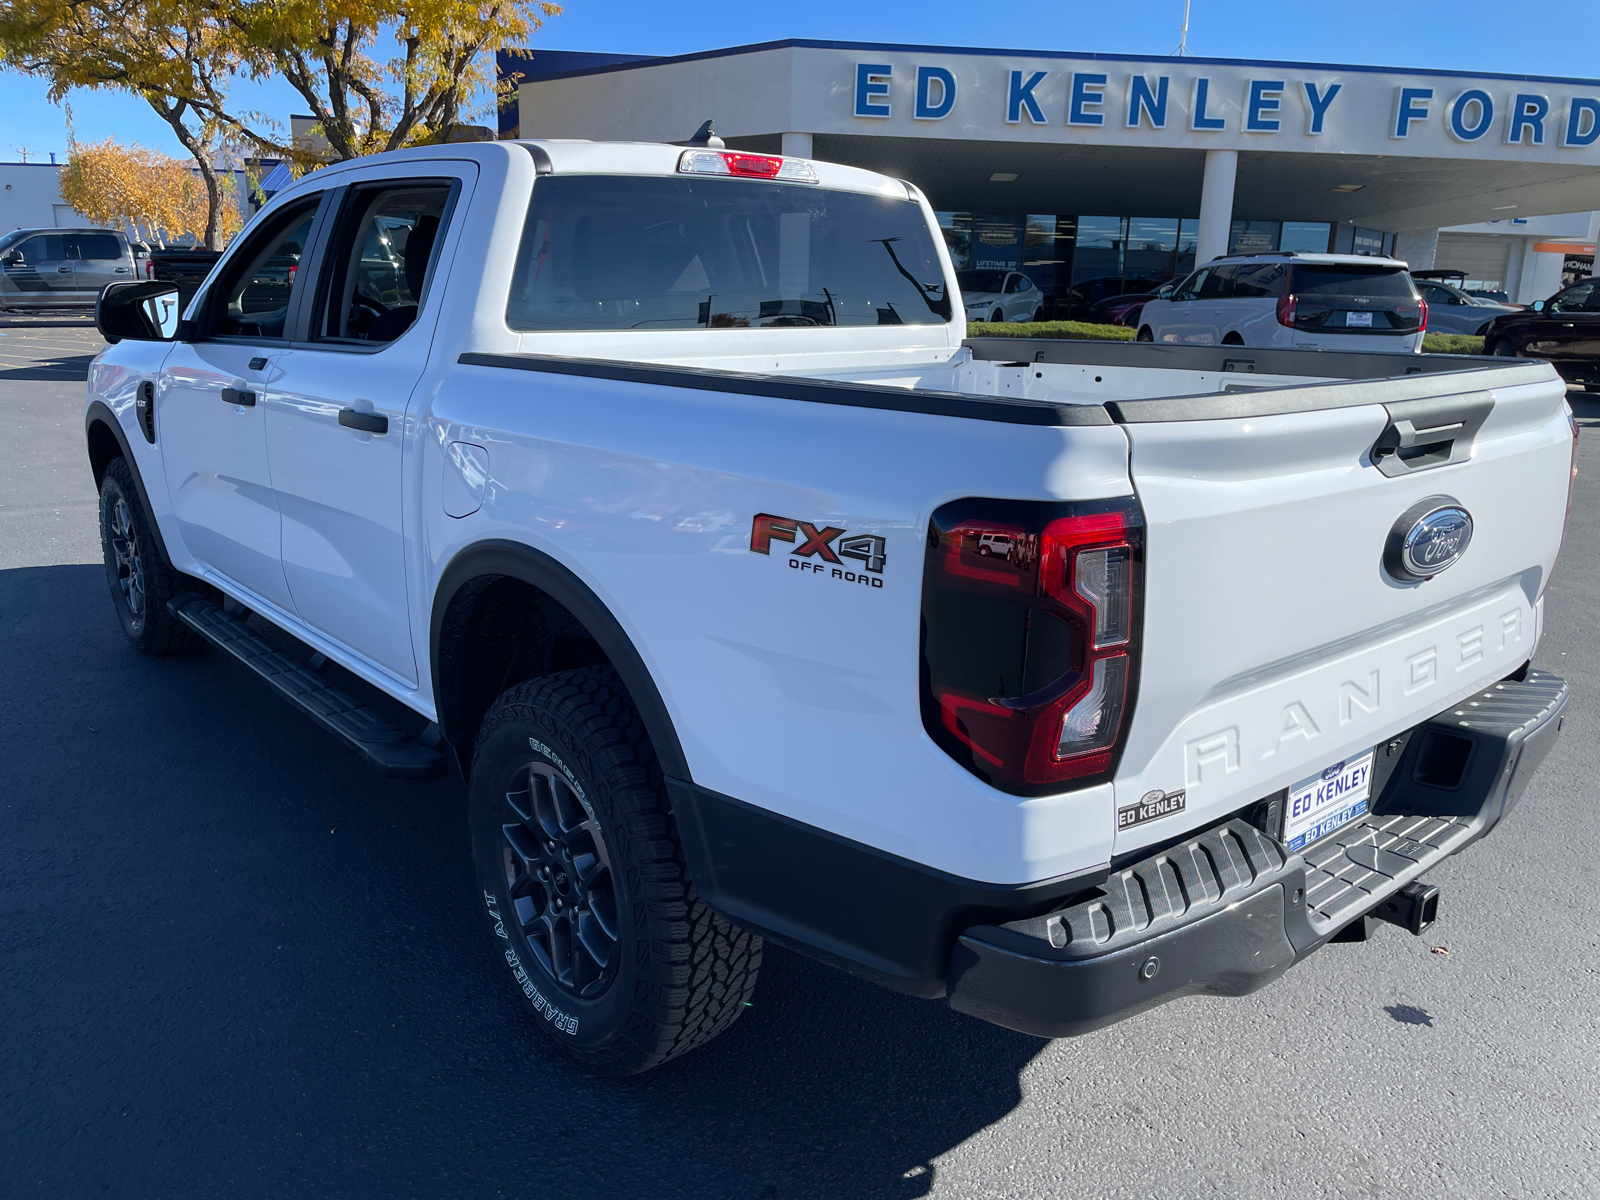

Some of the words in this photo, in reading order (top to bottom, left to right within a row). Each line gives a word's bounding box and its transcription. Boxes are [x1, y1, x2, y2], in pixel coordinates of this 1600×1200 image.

[854, 62, 958, 121] ED
[1005, 68, 1345, 136] KENLEY
[1391, 86, 1600, 148] FORD
[750, 512, 887, 574] FX4
[1424, 523, 1463, 563] Ford
[788, 558, 825, 574] OFF
[831, 567, 884, 589] ROAD
[1185, 605, 1523, 789] RANGER
[1119, 810, 1136, 825] ED
[1139, 794, 1185, 820] KENLEY
[1292, 793, 1312, 818] ED
[1316, 764, 1369, 806] KENLEY
[1304, 828, 1318, 843] ED
[1319, 806, 1354, 836] KENLEY
[484, 889, 509, 939] A/T
[504, 949, 579, 1036] GRABBER
